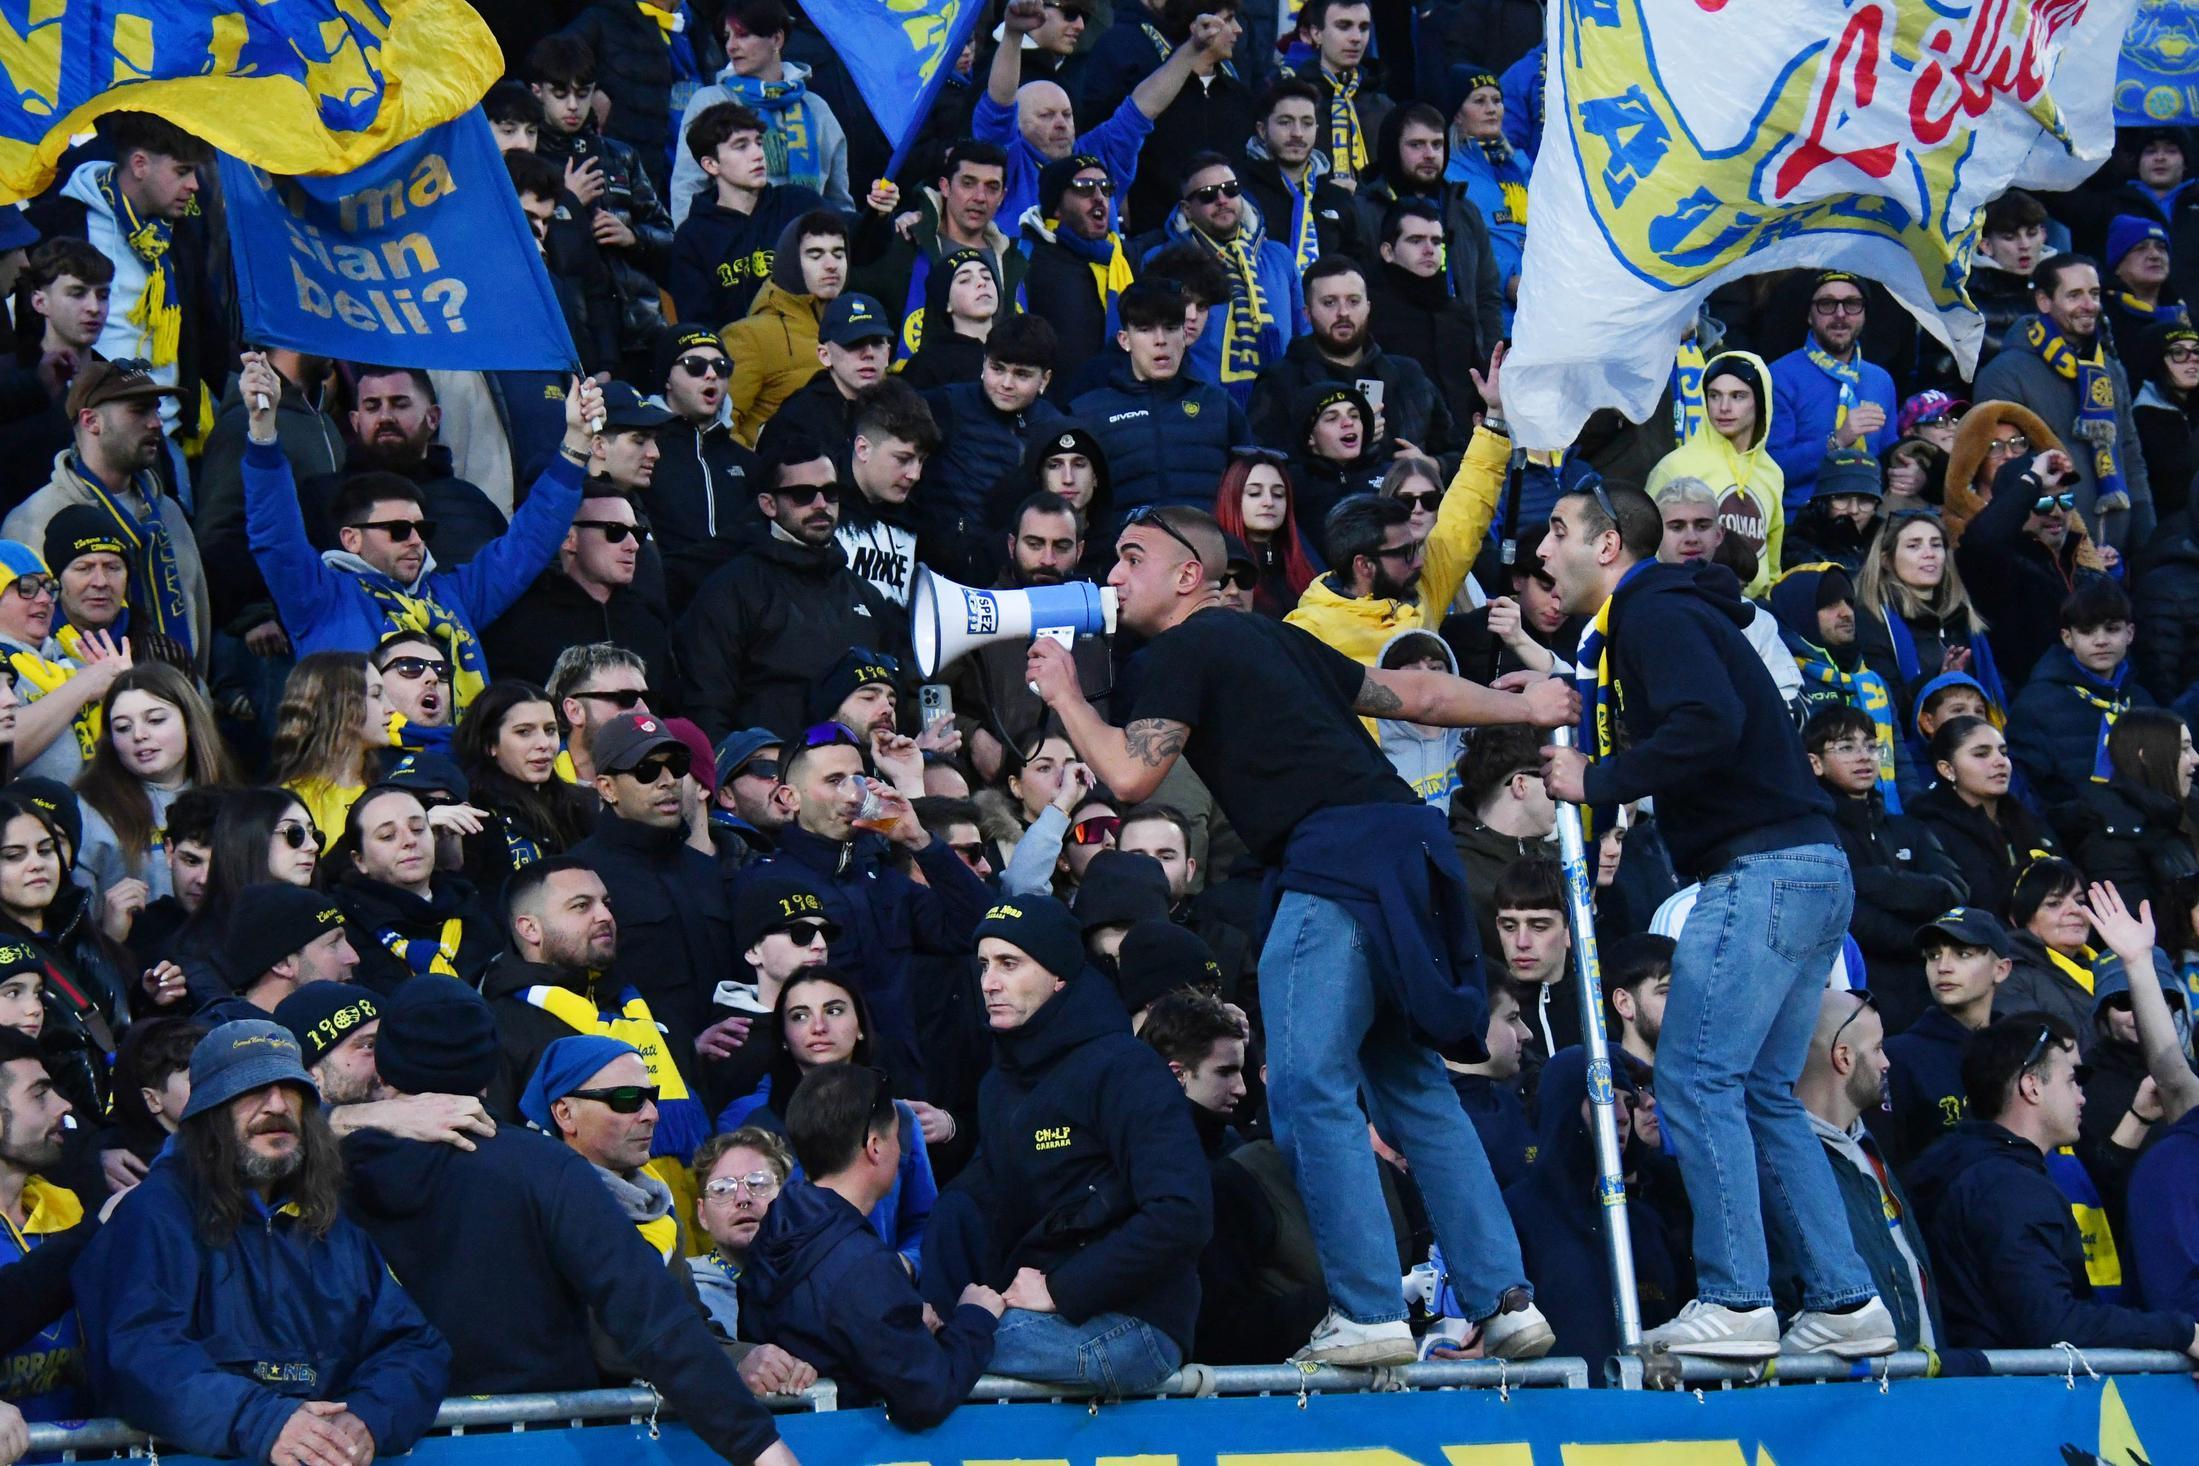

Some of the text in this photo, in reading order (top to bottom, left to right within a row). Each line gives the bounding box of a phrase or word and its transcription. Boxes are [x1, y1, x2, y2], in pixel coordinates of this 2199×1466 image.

[339, 154, 457, 232] ma
[289, 255, 468, 335] beli?
[1109, 410, 1149, 423] GIVOVA
[1718, 512, 1766, 541] COLMAR
[851, 546, 909, 588] NIKE
[1807, 690, 1839, 701] VOVA
